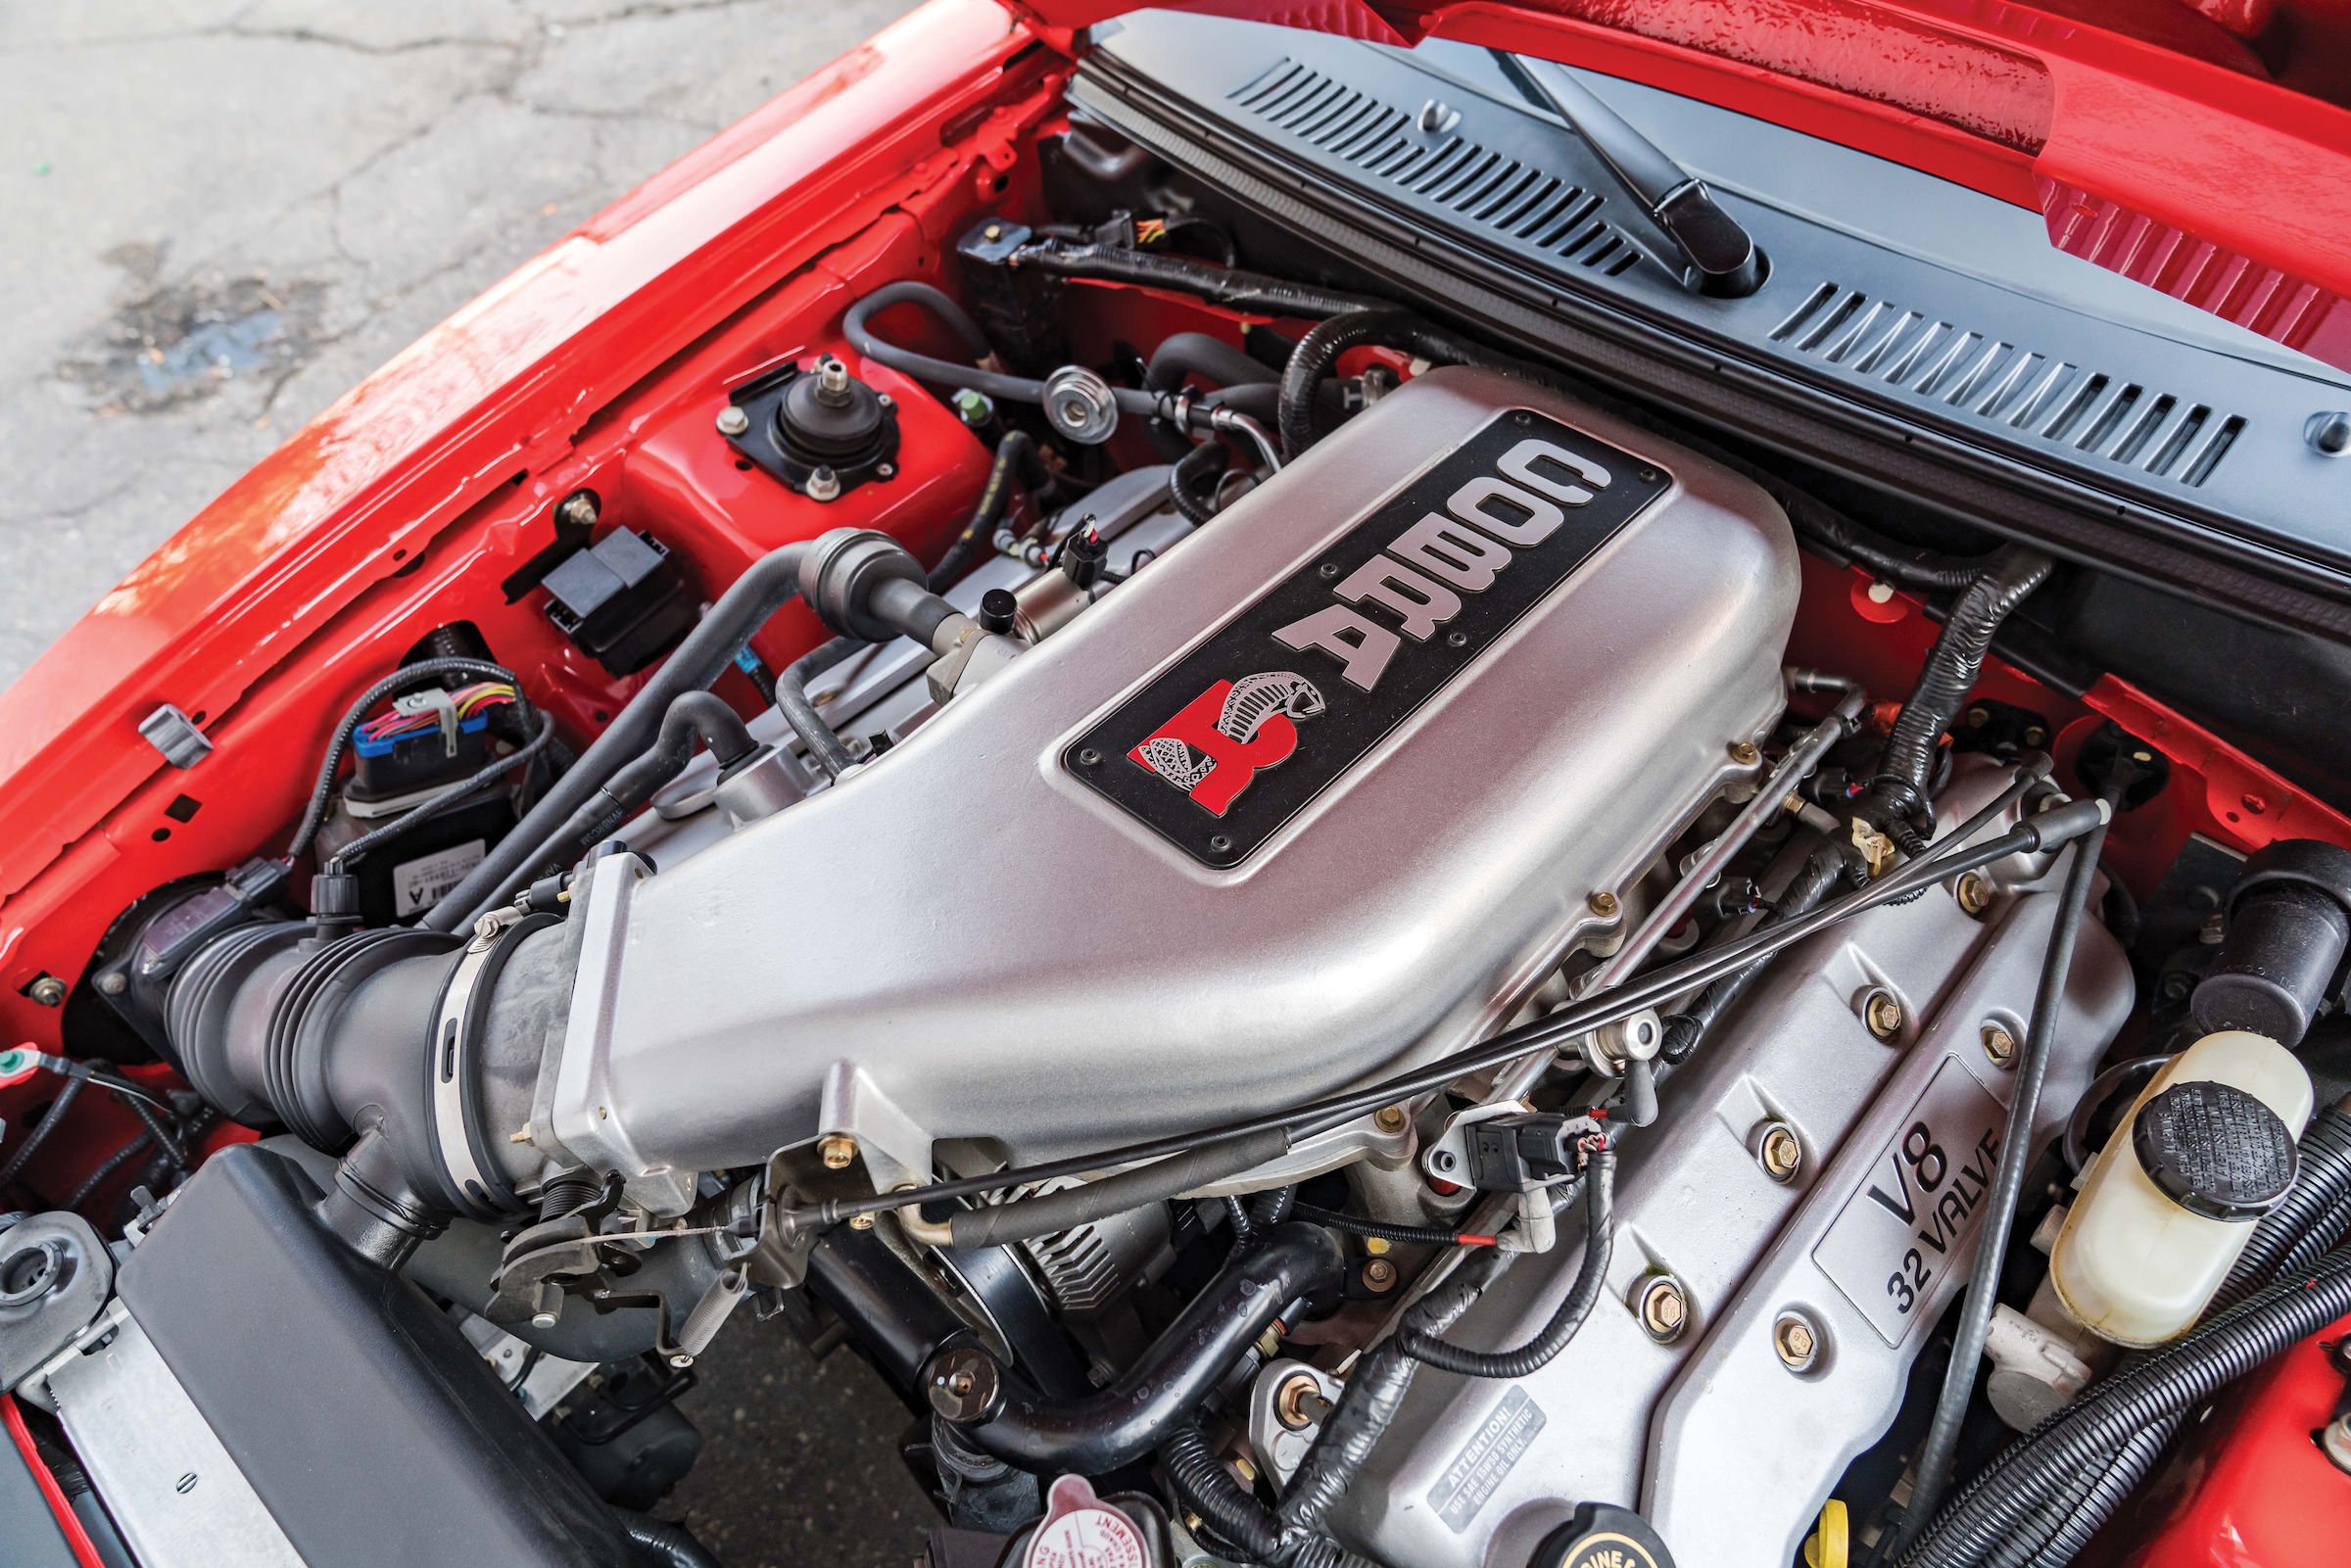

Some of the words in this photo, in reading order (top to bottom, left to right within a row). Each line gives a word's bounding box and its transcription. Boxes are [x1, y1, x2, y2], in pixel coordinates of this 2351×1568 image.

[1271, 439, 1611, 691] COBRA
[408, 886, 424, 905] A
[1865, 1121, 1947, 1226] V8
[1887, 1248, 1932, 1314] 32
[1917, 1127, 1999, 1255] VALVE
[1448, 1405, 1511, 1488] ATTENTION!
[1450, 1495, 1467, 1514] USE
[1463, 1477, 1480, 1497] SAE
[1476, 1450, 1499, 1481] 15W50
[1497, 1408, 1532, 1453] SYNTHETIC
[1472, 1472, 1499, 1505] ENGINE
[1497, 1460, 1511, 1476] OIL
[1507, 1437, 1527, 1461] ONLY.
